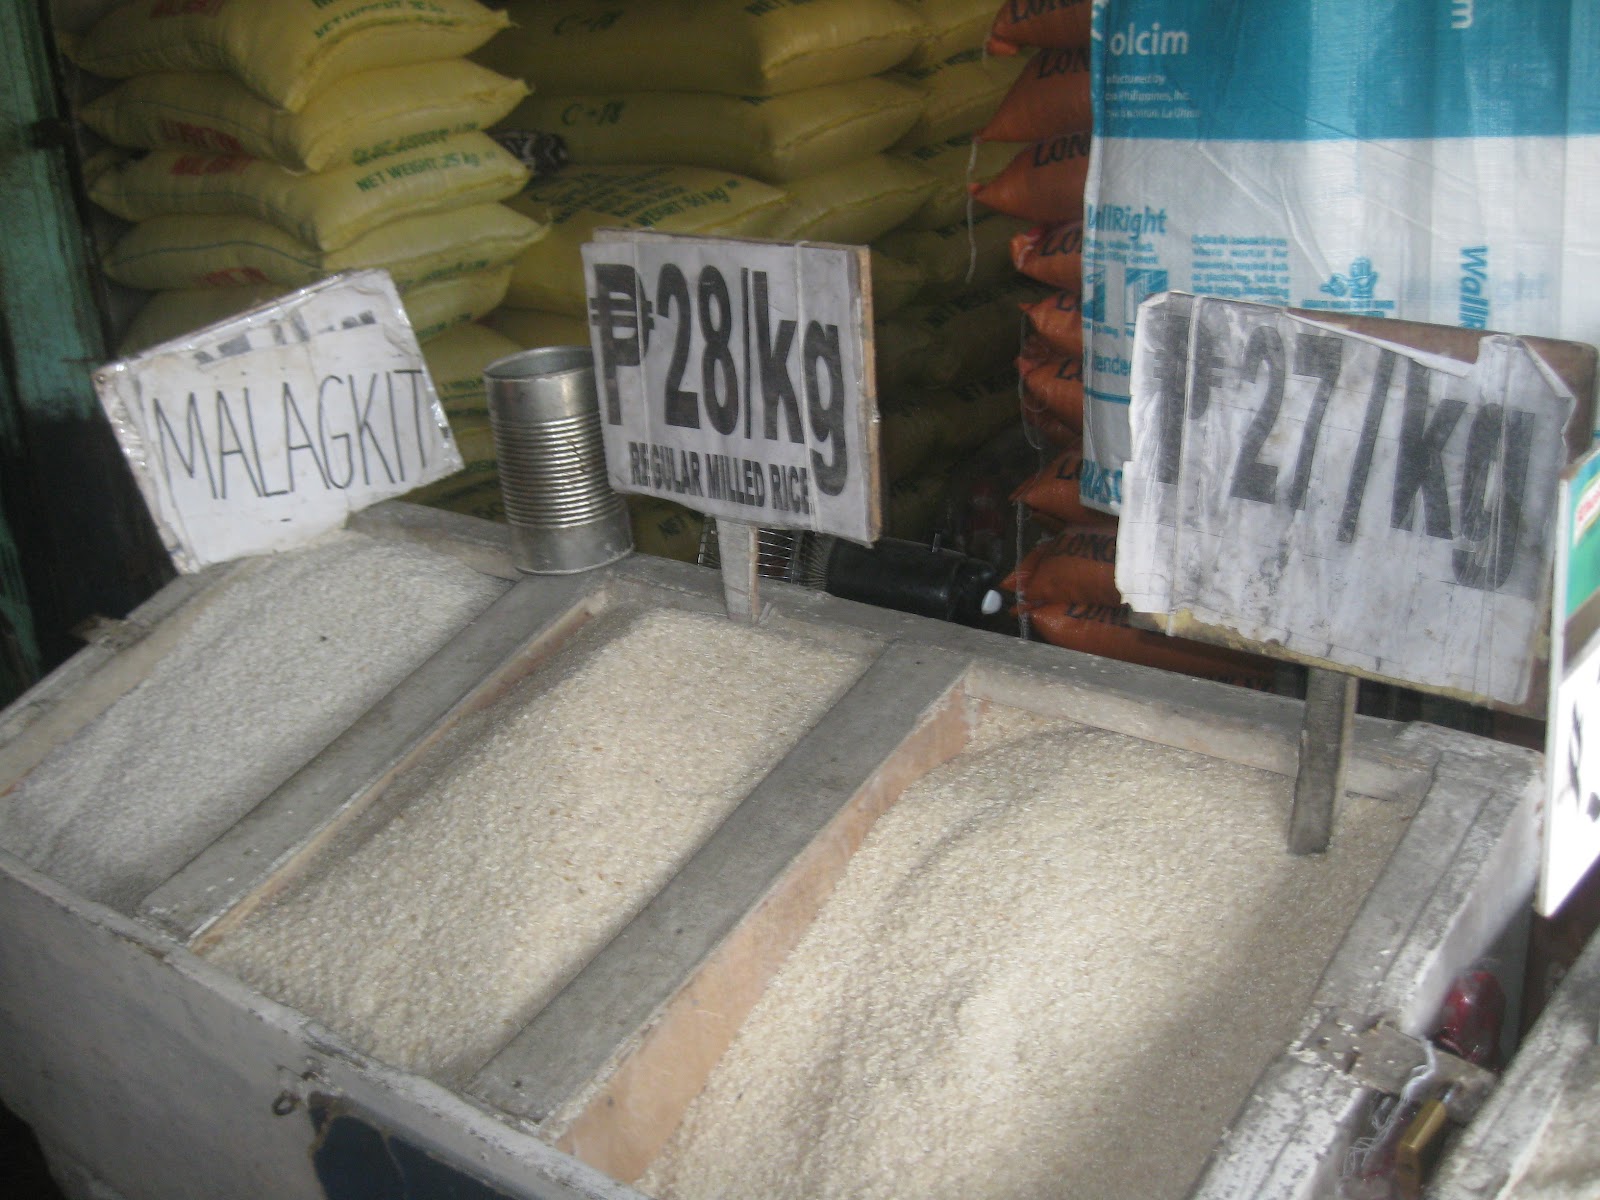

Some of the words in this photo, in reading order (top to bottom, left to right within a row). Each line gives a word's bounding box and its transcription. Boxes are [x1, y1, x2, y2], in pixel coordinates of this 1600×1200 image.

[1108, 22, 1189, 57] olcim
[152, 368, 426, 500] MALAGKIT
[628, 441, 704, 498] REGULAR
[704, 453, 766, 509] MILLED
[767, 462, 814, 515] RICE
